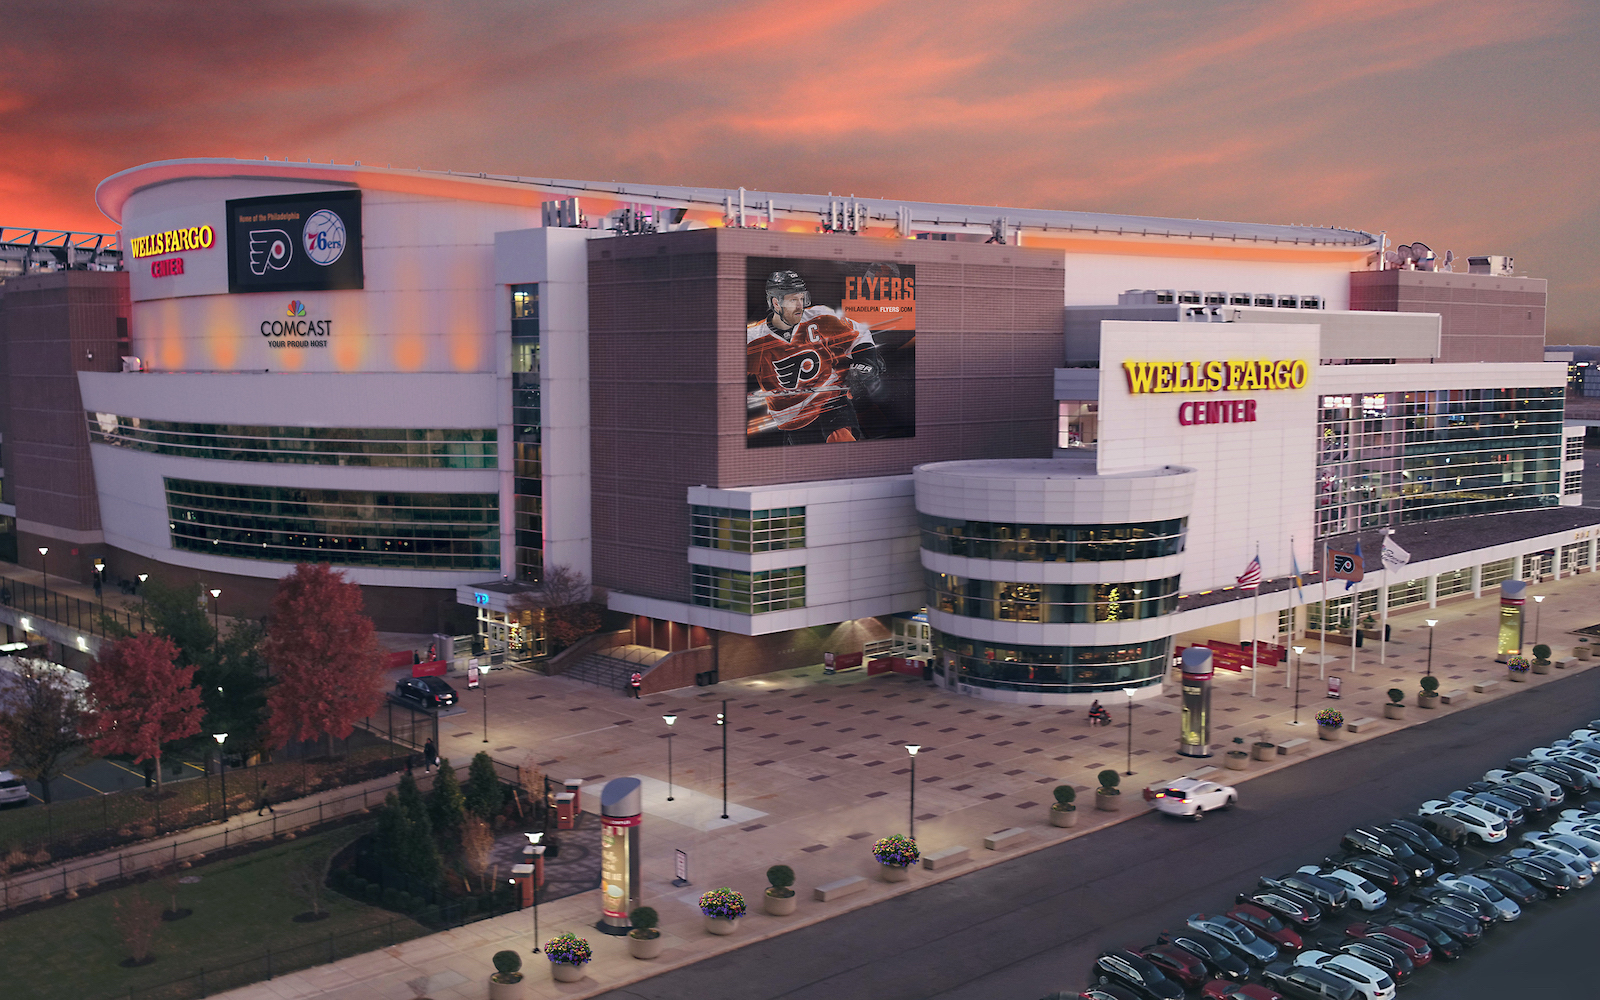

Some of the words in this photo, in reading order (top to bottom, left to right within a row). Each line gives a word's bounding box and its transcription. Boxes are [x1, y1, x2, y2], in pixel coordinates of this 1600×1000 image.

[239, 215, 252, 223] Home
[253, 214, 258, 222] of
[258, 214, 267, 222] the
[267, 212, 300, 222] Philadelphia
[130, 232, 164, 259] WELLS
[164, 225, 215, 253] FARGO
[308, 231, 341, 251] 76ers
[151, 257, 184, 278] CENTER
[845, 276, 914, 300] FLYERS
[260, 320, 332, 337] COMCAST
[807, 323, 820, 343] C
[268, 340, 286, 348] YOUR
[287, 340, 309, 348] PROUD
[1122, 360, 1223, 394] WELLS
[1224, 359, 1308, 391] FARGO
[1179, 399, 1257, 426] CENTER
